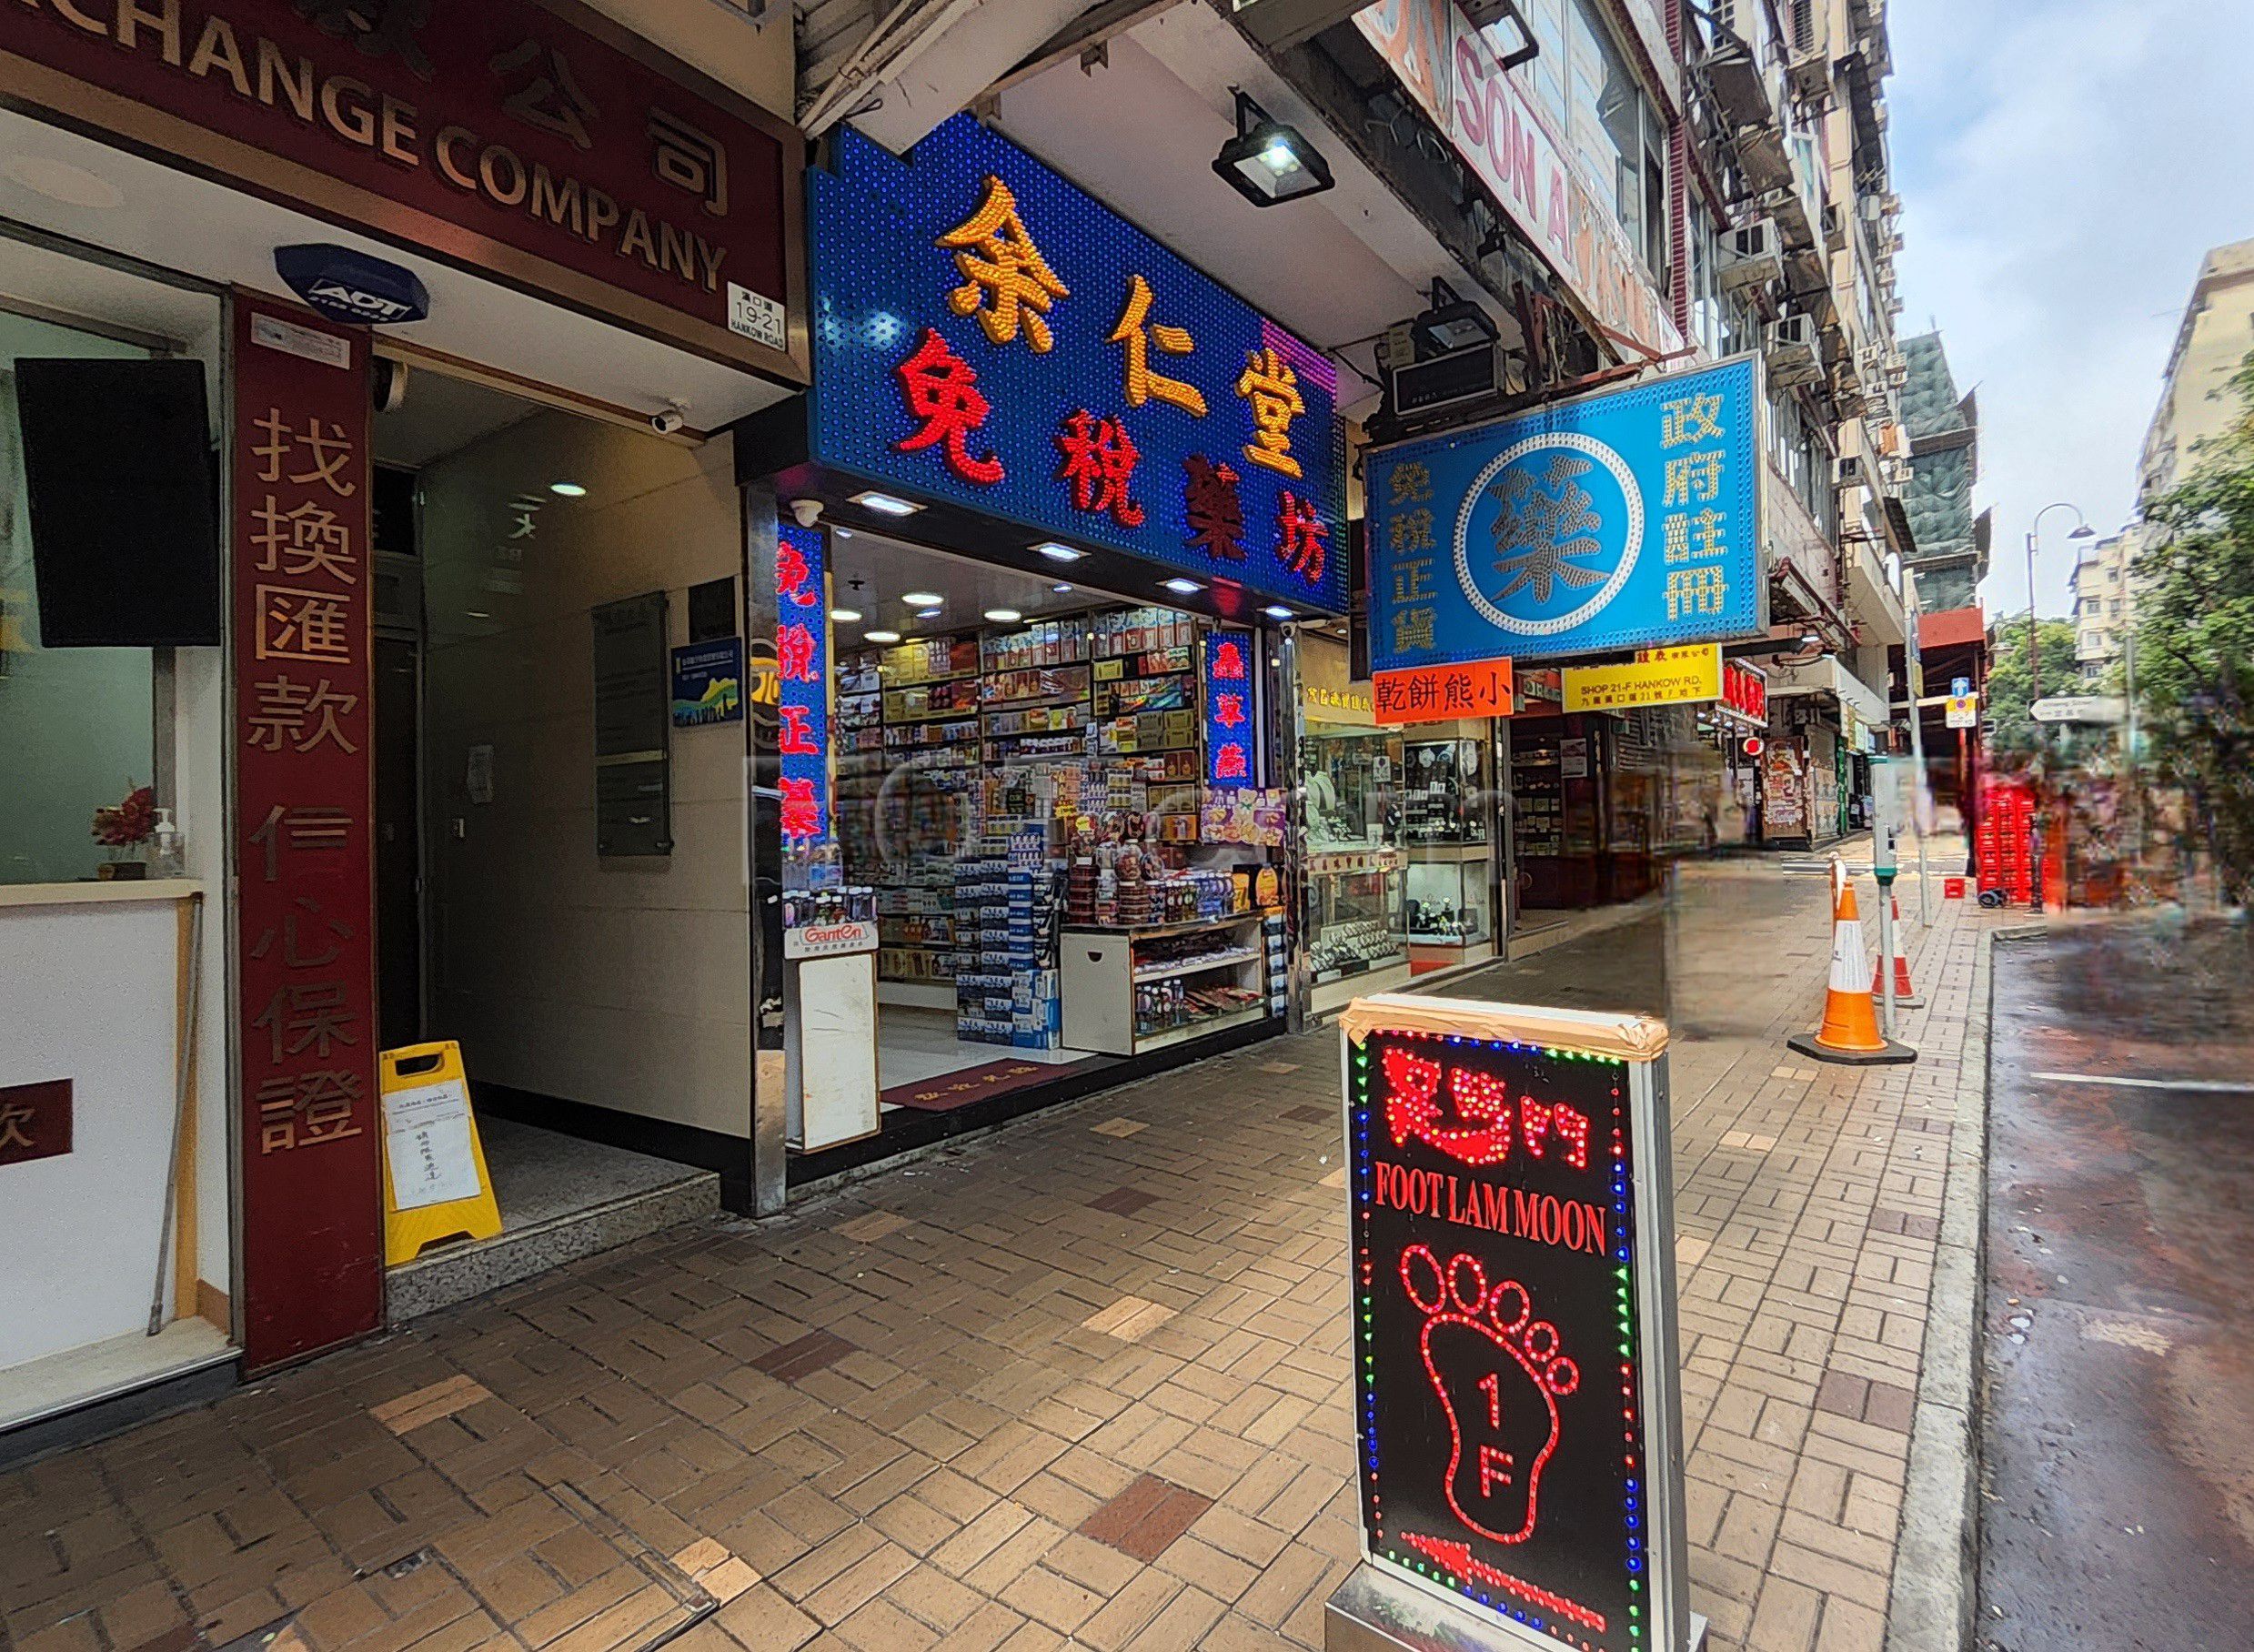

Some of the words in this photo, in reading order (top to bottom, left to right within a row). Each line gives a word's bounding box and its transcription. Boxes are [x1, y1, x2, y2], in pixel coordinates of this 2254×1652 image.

[436, 126, 728, 292] COMPANY
[313, 287, 413, 317] ADT
[736, 301, 781, 335] 19-21
[934, 175, 1305, 479] 余仁堂
[730, 318, 763, 338] HANKOW
[764, 331, 783, 349] ROAD
[1486, 455, 1612, 605] 藥
[247, 408, 358, 755] 找換匯款
[1581, 684, 1607, 695] SHOP
[1611, 681, 1631, 692] 21-F
[1635, 677, 1681, 690] HANKOW
[1684, 676, 1702, 685] RD.
[1375, 1162, 1444, 1218] FOOT
[1447, 1174, 1510, 1234] LAM
[1512, 1188, 1606, 1256] MOON
[1476, 1373, 1500, 1430] 1
[1479, 1445, 1514, 1498] F
